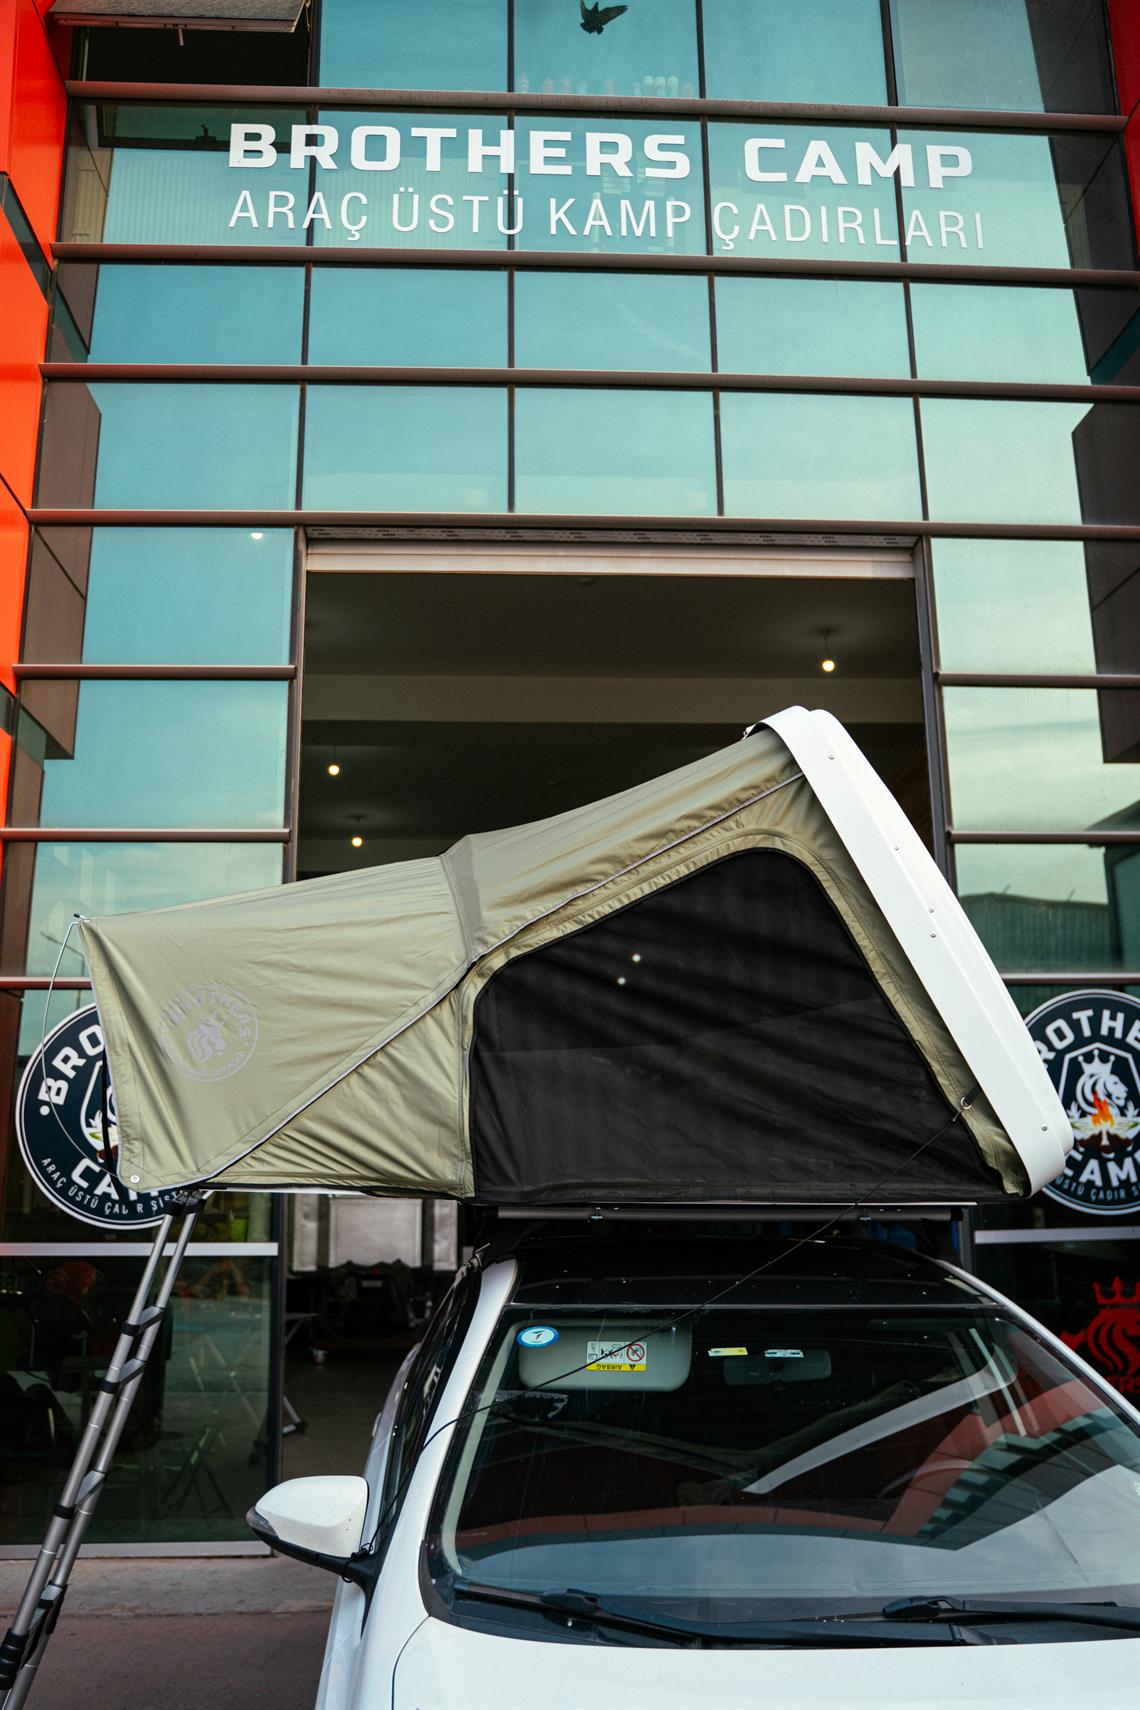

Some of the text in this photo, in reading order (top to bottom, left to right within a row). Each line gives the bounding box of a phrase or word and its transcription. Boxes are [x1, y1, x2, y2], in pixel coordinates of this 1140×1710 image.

[228, 122, 973, 189] BROTHERS CAMP
[228, 187, 985, 250] ARAÇ ÜSTÜ KAMP ÇADIRLARI
[41, 1157, 67, 1189] ARAÇ
[68, 1185, 99, 1209] ÜSTÜ
